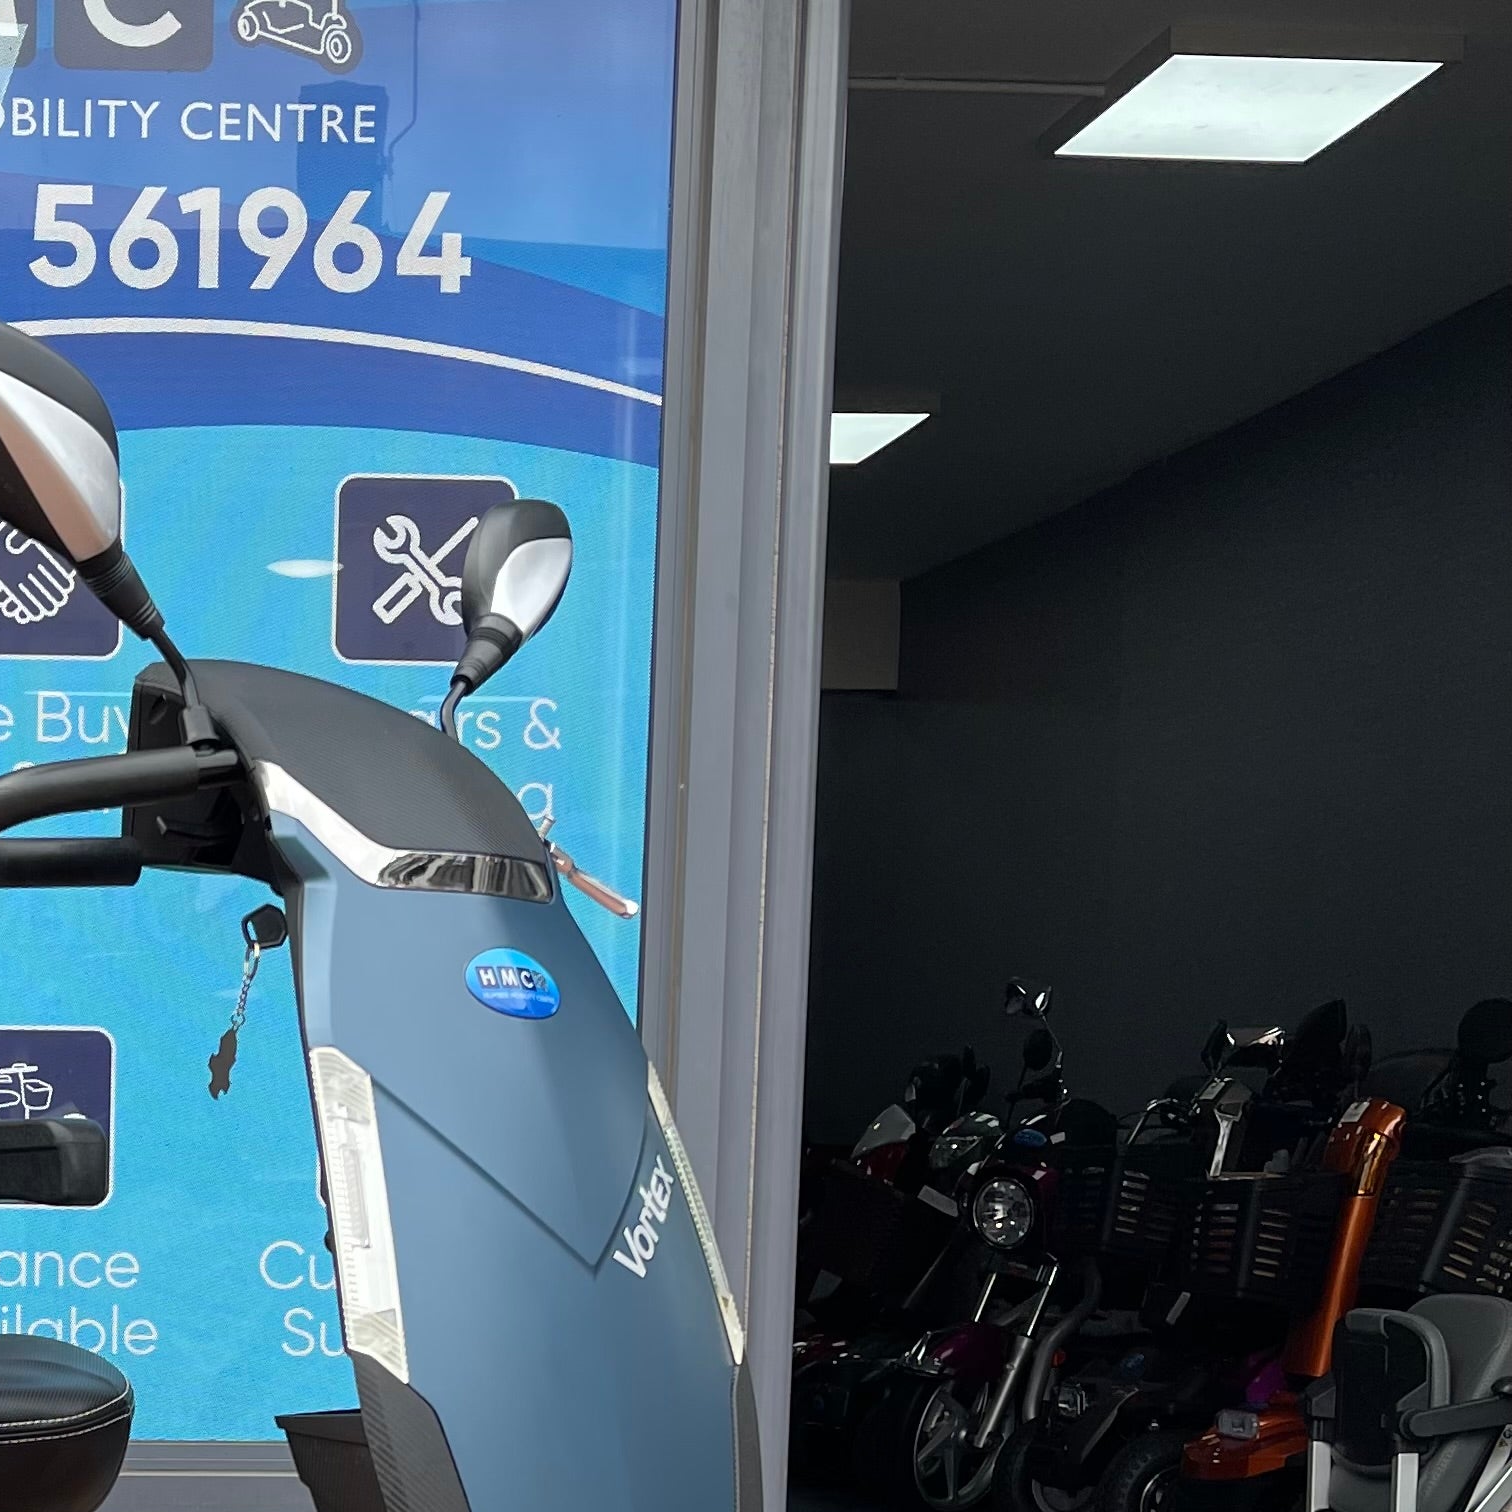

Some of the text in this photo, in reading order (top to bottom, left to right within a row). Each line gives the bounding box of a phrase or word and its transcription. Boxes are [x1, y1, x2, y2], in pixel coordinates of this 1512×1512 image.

[181, 102, 376, 144] CENTRE
[29, 183, 472, 294] 561964
[523, 697, 562, 750] &
[478, 968, 534, 989] HMC
[612, 1154, 674, 1278] Vortex
